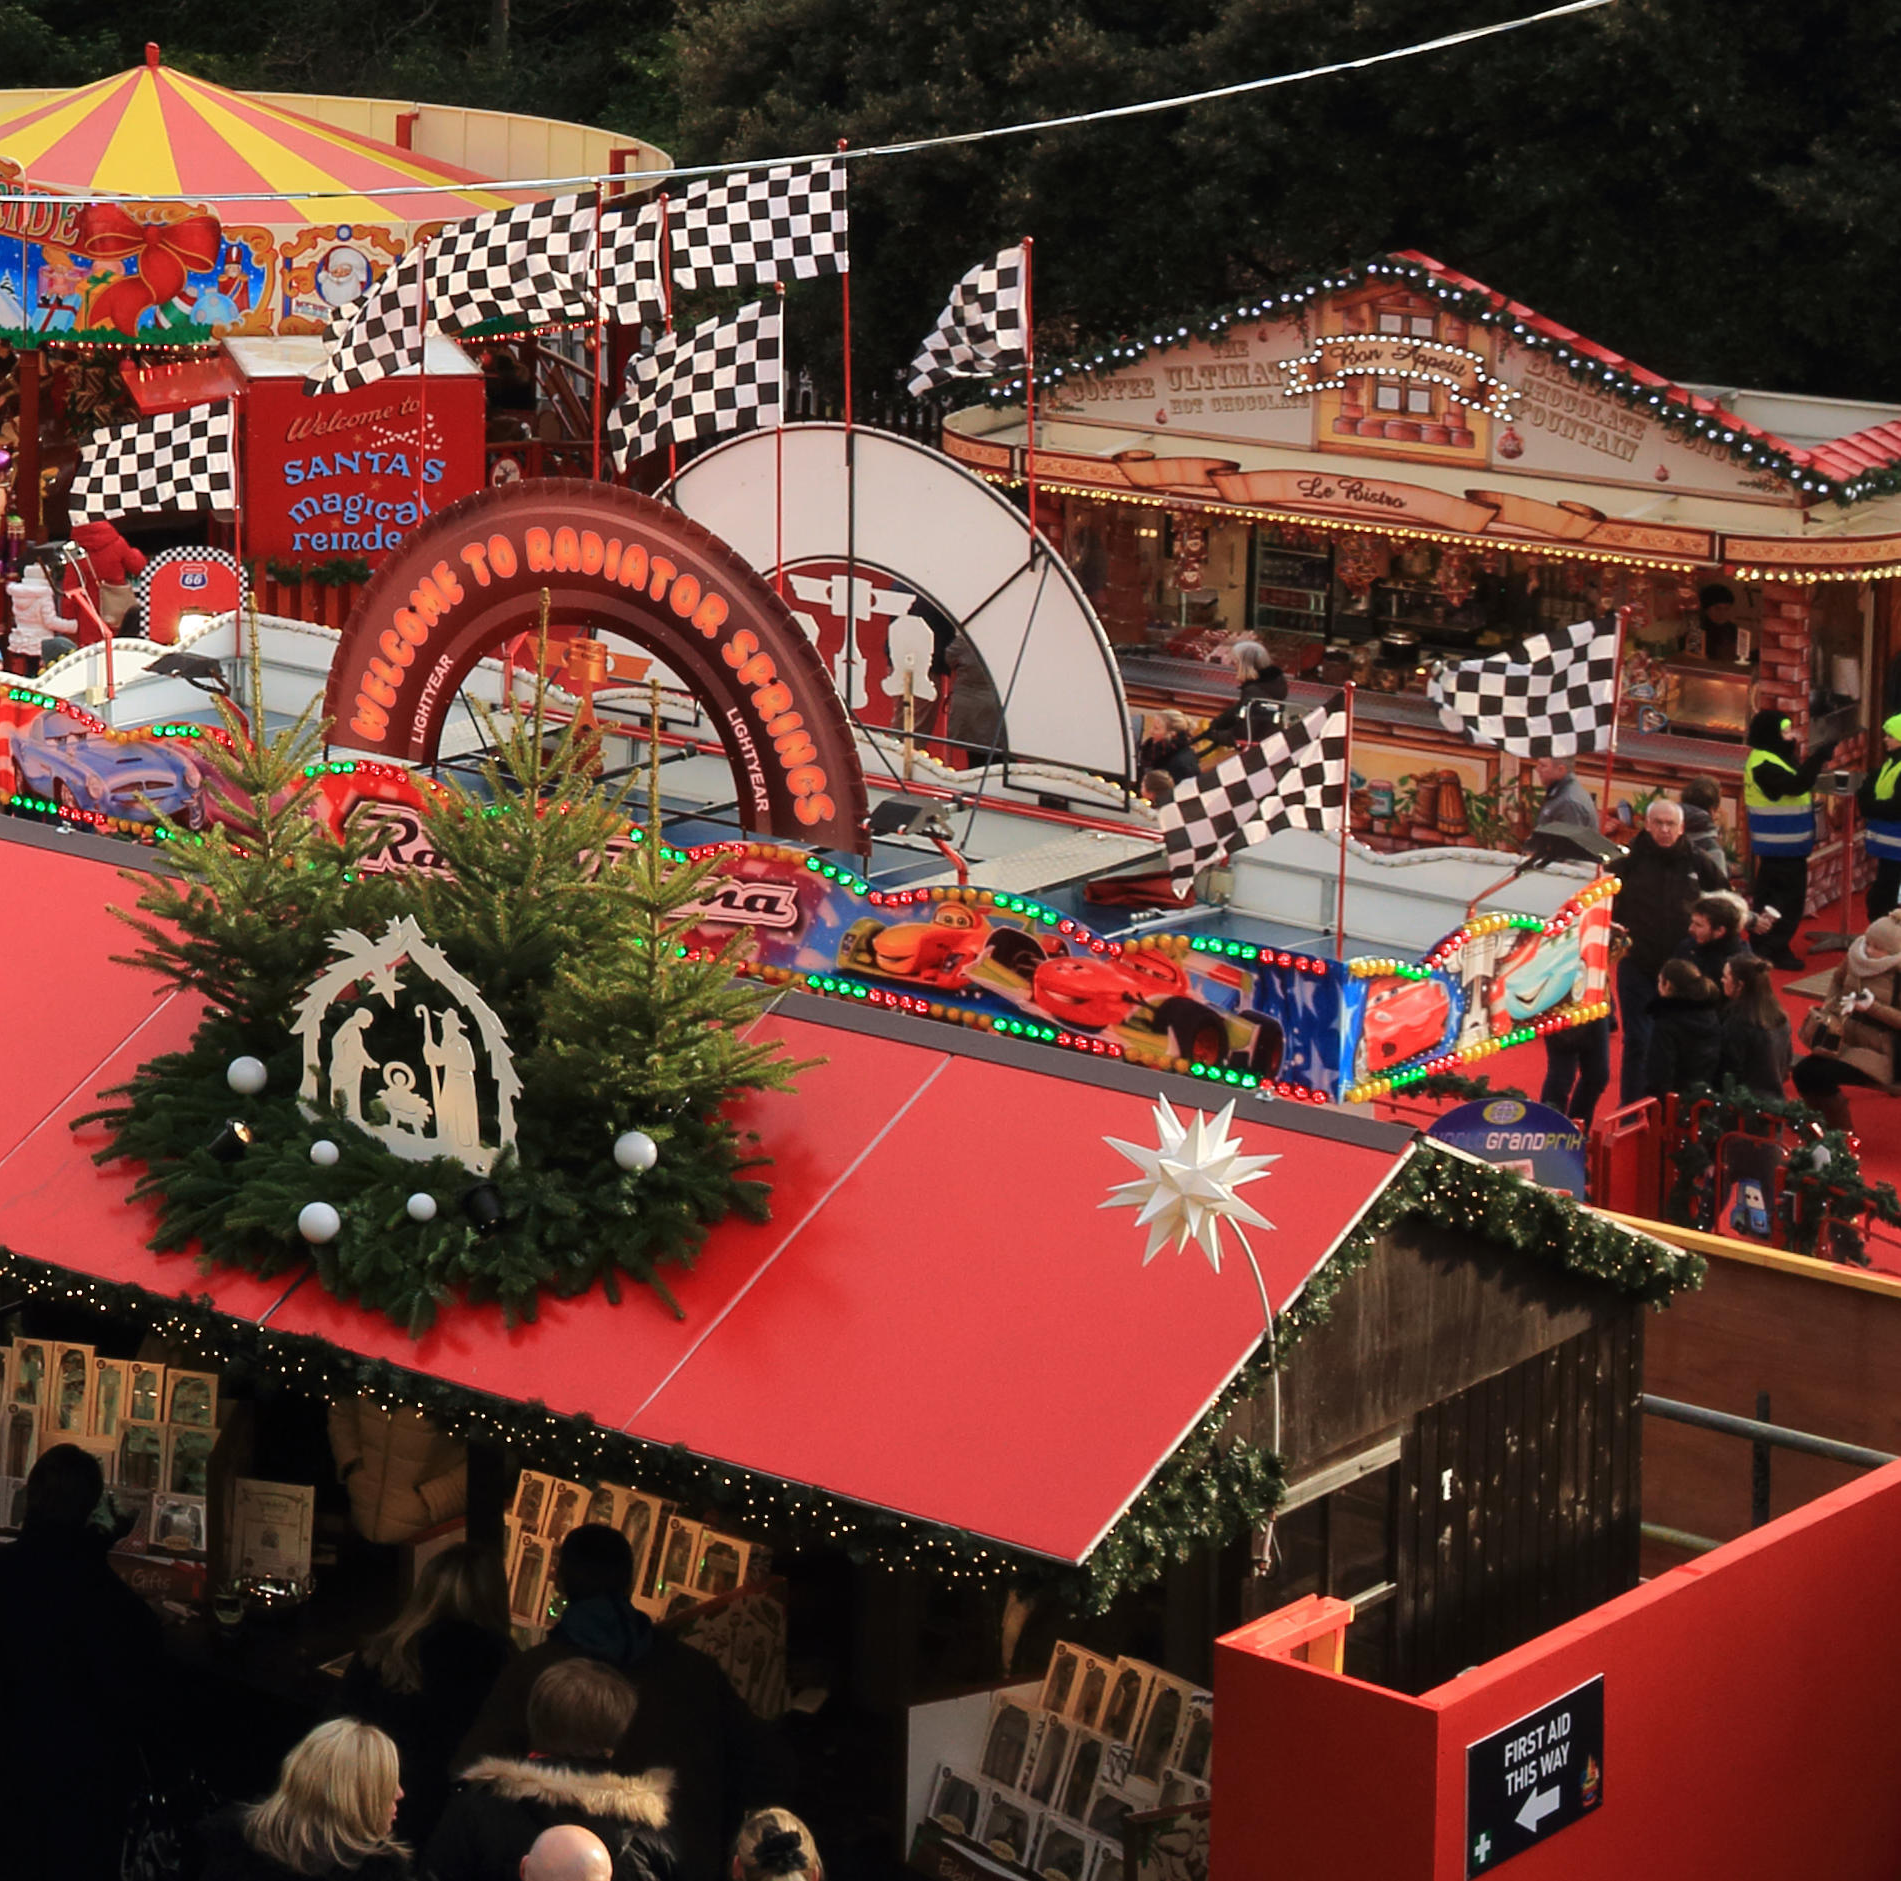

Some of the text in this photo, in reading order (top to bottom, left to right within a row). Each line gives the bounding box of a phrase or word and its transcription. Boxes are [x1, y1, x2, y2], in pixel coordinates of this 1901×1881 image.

[1163, 360, 1291, 392] ULTIMAT
[1329, 345, 1468, 378] Bon Appetit
[1069, 376, 1156, 403] COFFEE
[1169, 393, 1311, 415] HOT CHOCOLATE
[286, 395, 421, 444] Welcome to
[284, 451, 447, 486] SANTA'S
[1296, 477, 1406, 509] Le Bistro
[292, 523, 405, 552] reinde
[184, 574, 202, 585] 66
[349, 525, 837, 826] WELCOME TO RADIATOR SPRINGS
[410, 652, 455, 745] LIGHTYEAR
[725, 706, 770, 814] LIGHTYEAR
[130, 1568, 173, 1592] Gifts
[1504, 1712, 1571, 1768] FIRST AID
[1505, 1741, 1571, 1797] THIS WAY
